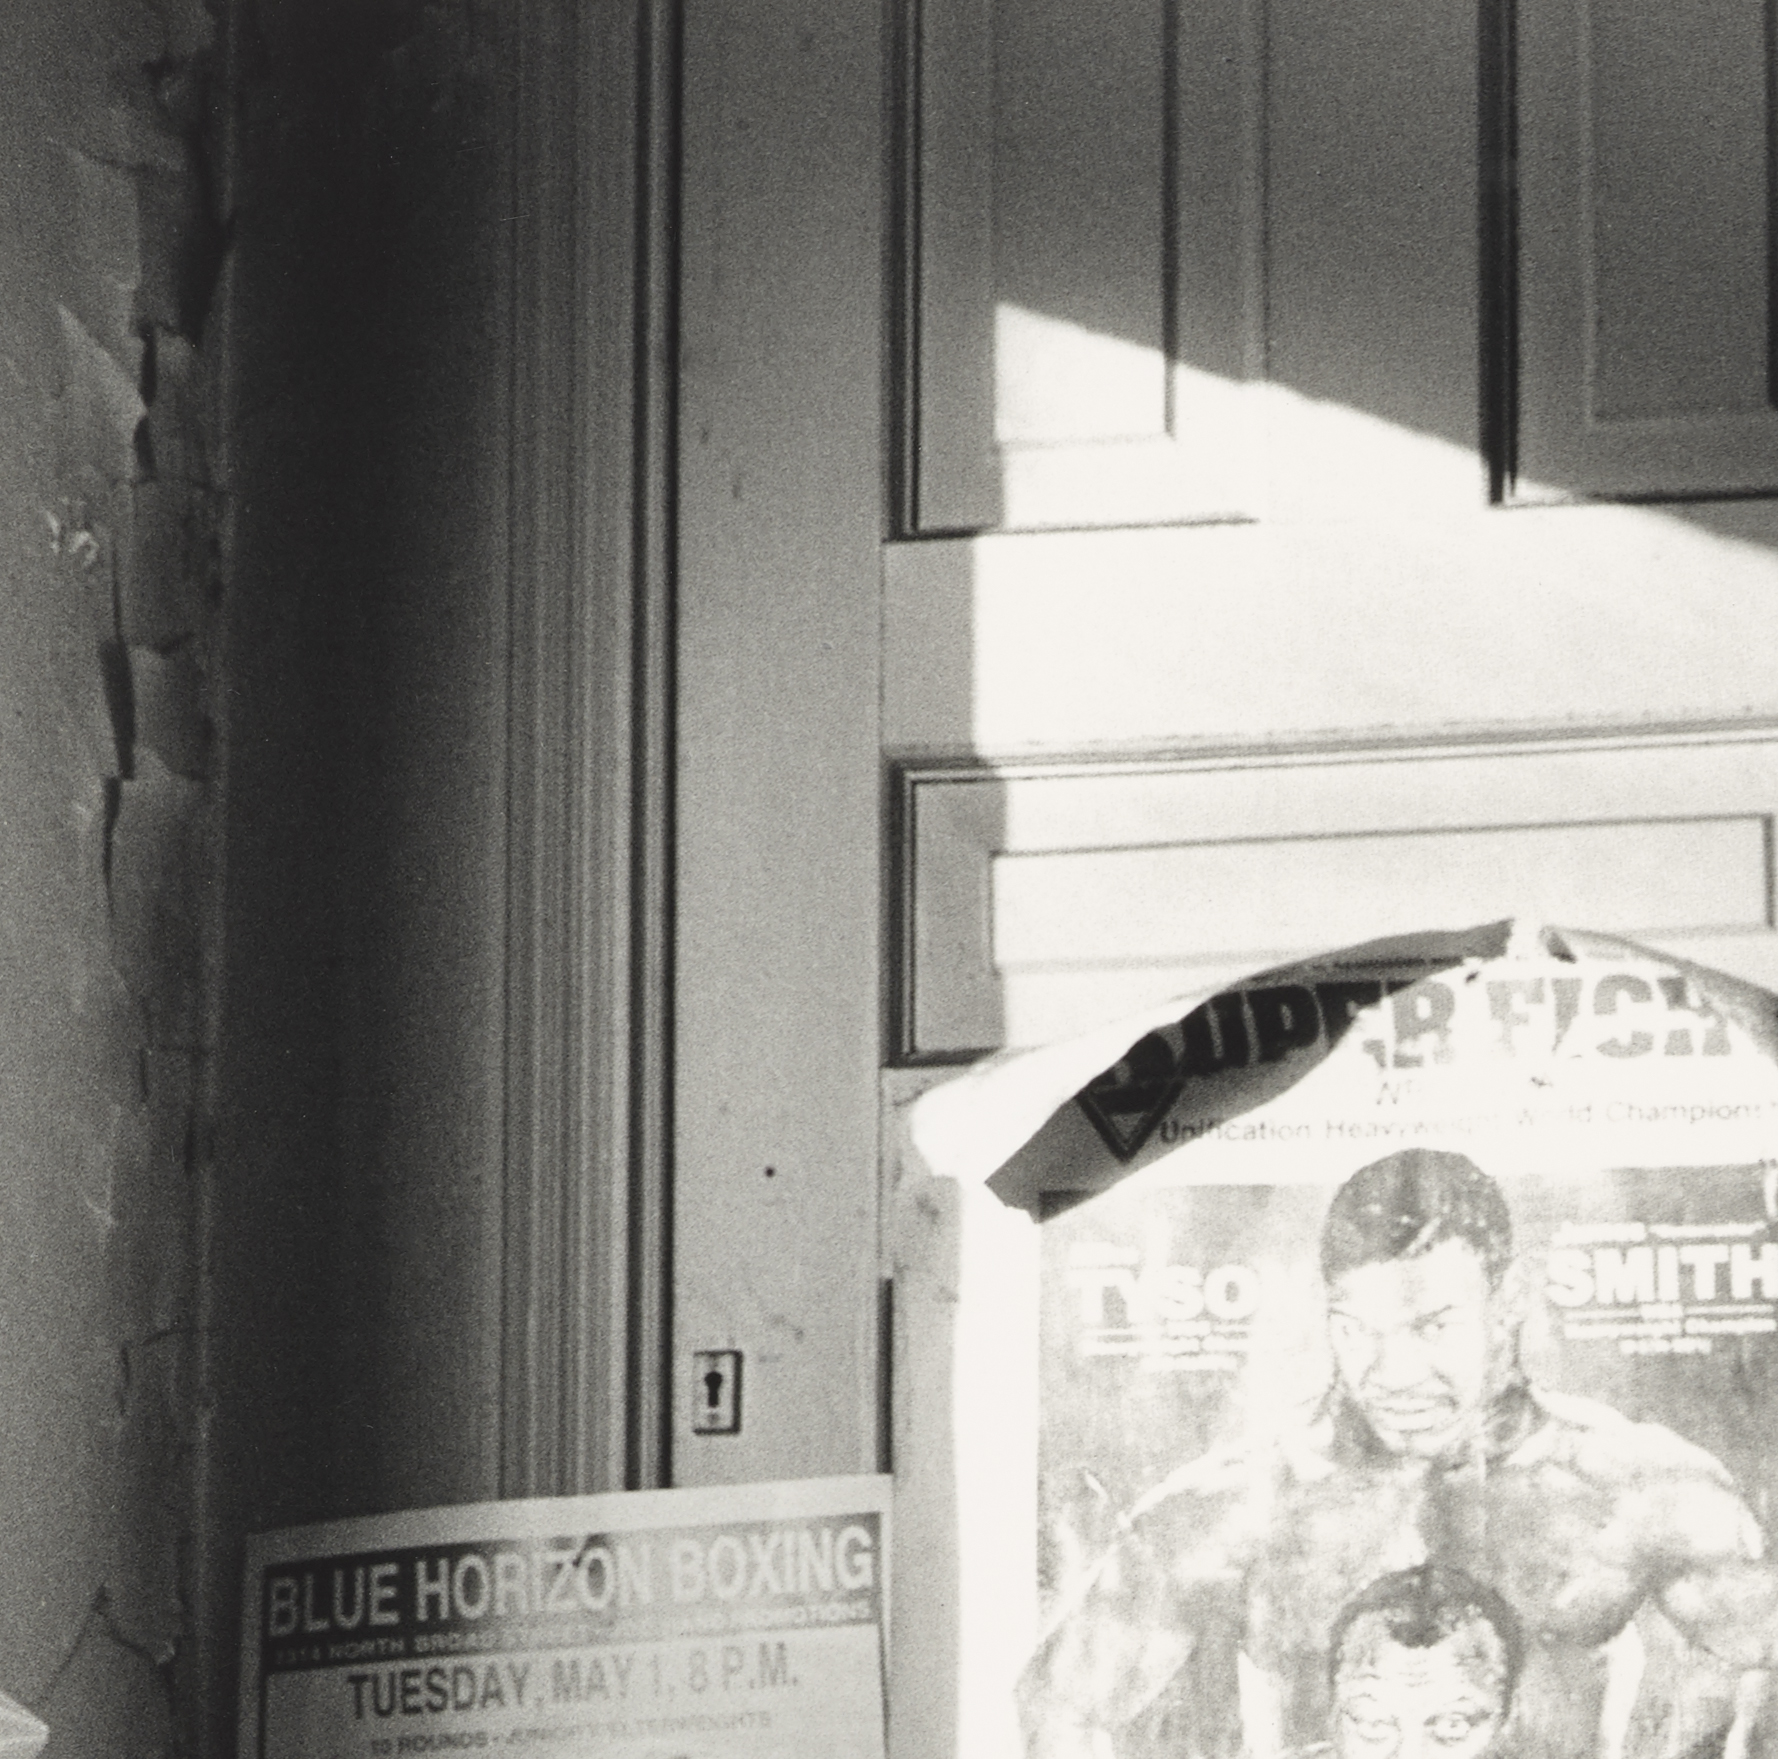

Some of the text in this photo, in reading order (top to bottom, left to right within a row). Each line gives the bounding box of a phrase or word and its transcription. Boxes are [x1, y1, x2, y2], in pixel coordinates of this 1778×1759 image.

[269, 1522, 876, 1638] BLUE HORIZON BOXING
[349, 1640, 799, 1722] TUESDAY, MAY 8 P.M.
